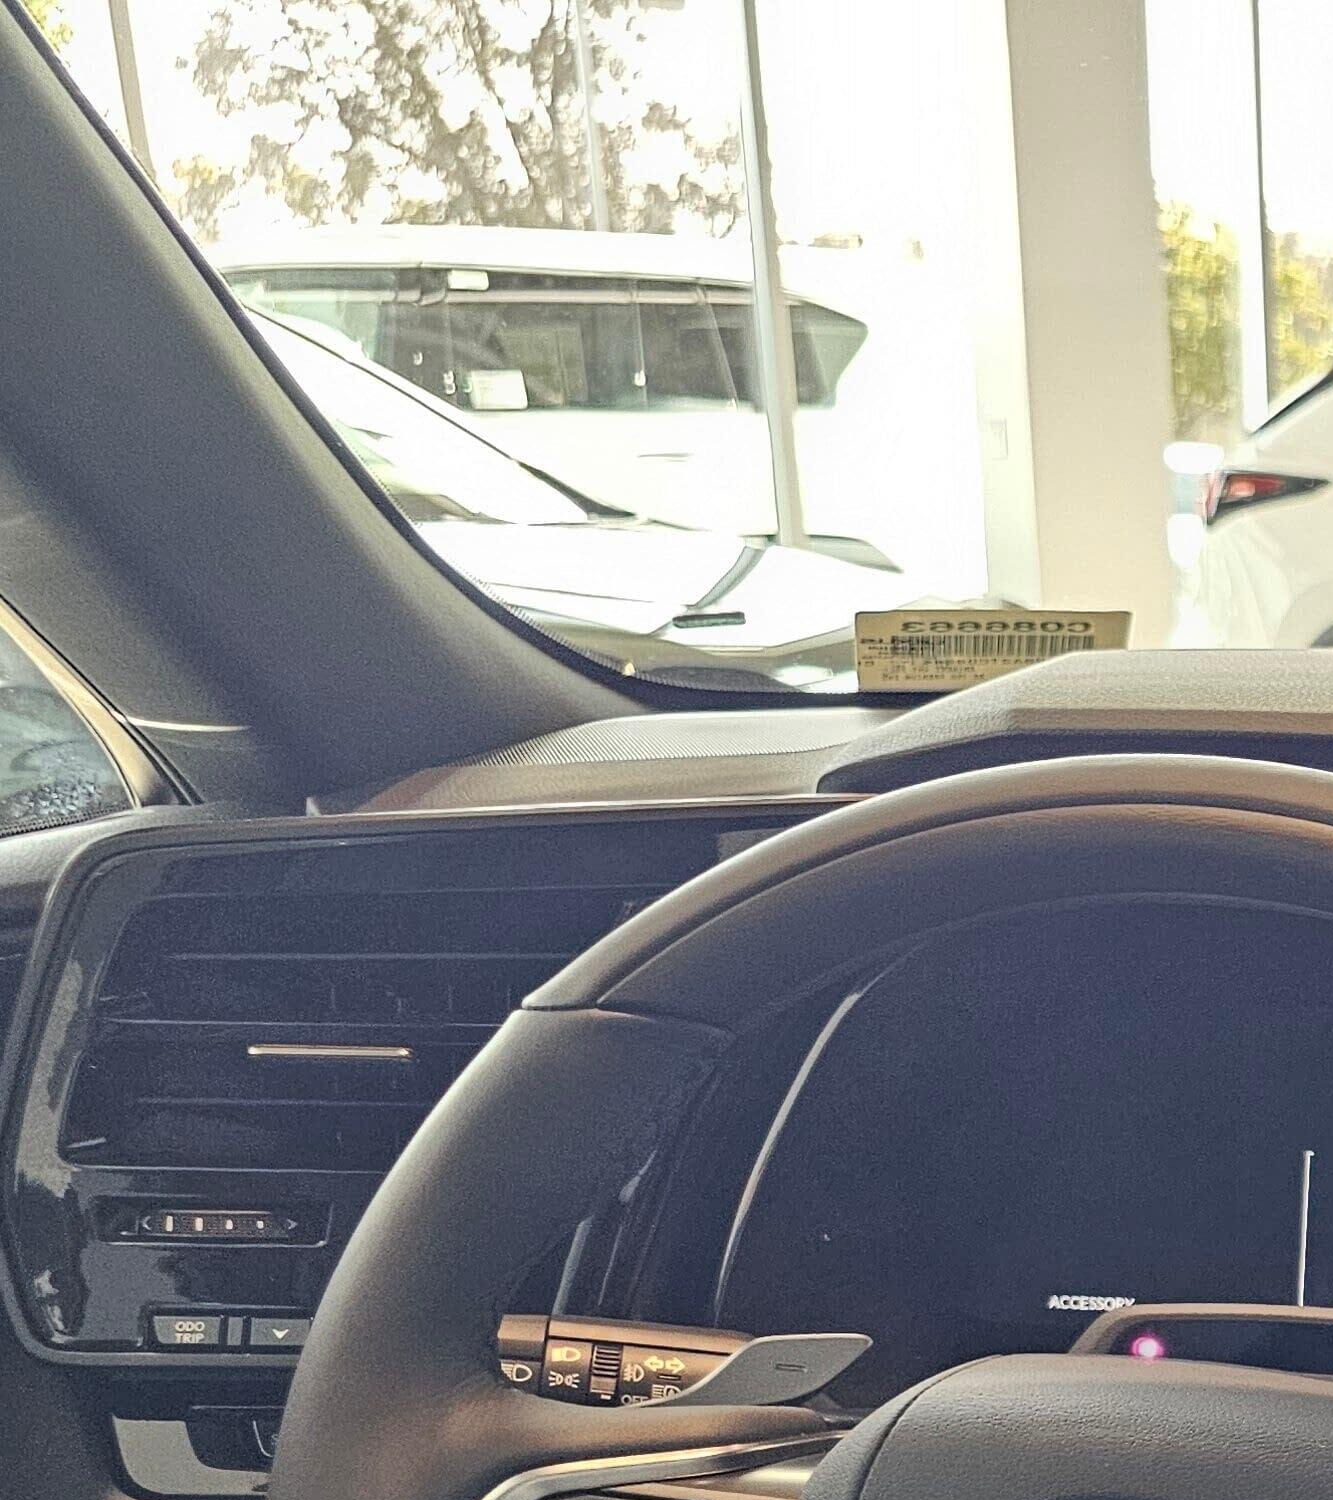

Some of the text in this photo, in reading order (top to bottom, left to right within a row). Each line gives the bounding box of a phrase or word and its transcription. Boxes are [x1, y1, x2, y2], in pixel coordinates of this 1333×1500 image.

[1048, 1293, 1137, 1312] ACCESSORY
[174, 1321, 206, 1333] ODO
[174, 1332, 206, 1344] TRIP
